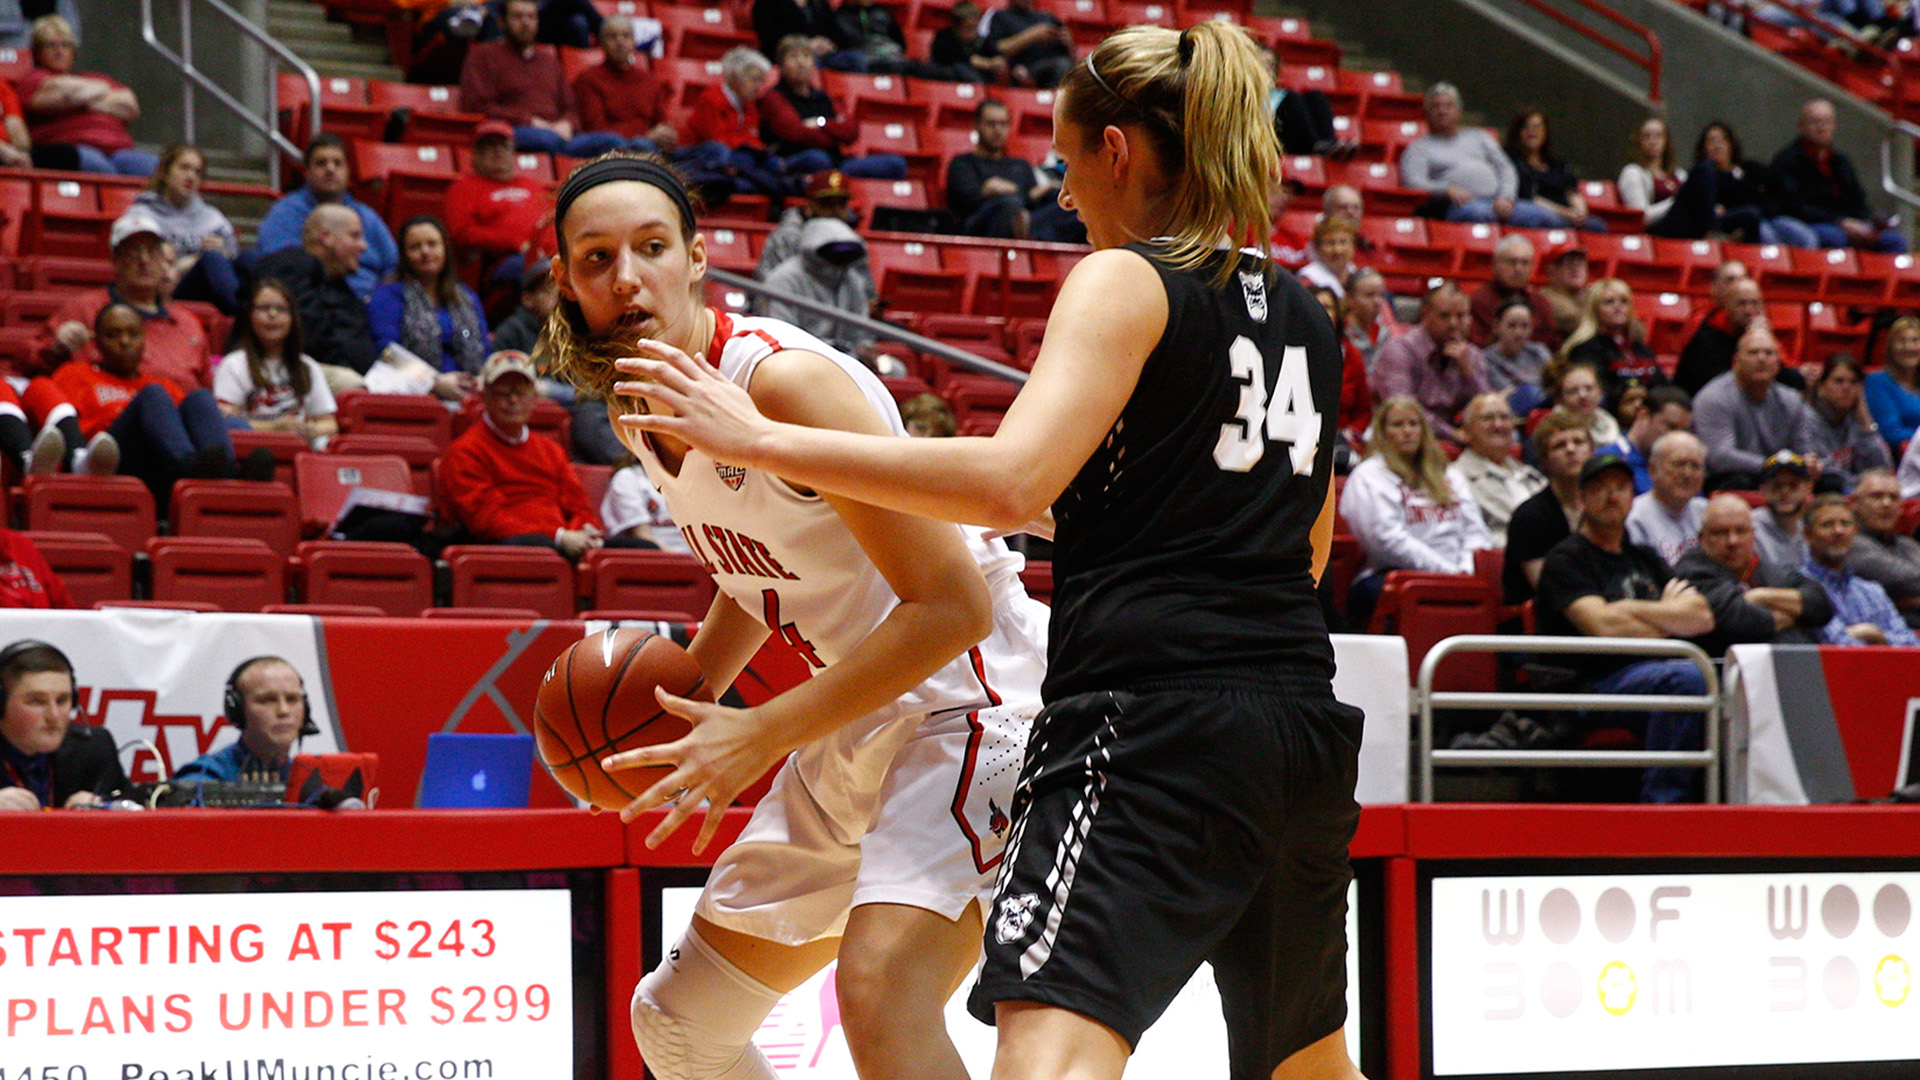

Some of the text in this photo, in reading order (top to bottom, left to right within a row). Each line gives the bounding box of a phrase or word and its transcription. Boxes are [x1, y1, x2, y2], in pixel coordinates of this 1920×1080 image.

[1213, 335, 1322, 477] 34
[702, 523, 801, 580] STATE
[288, 922, 352, 961] AT
[374, 918, 497, 964] $243
[1482, 886, 1692, 945] WOOF
[7, 984, 552, 1037] PLANS UNDER $299
